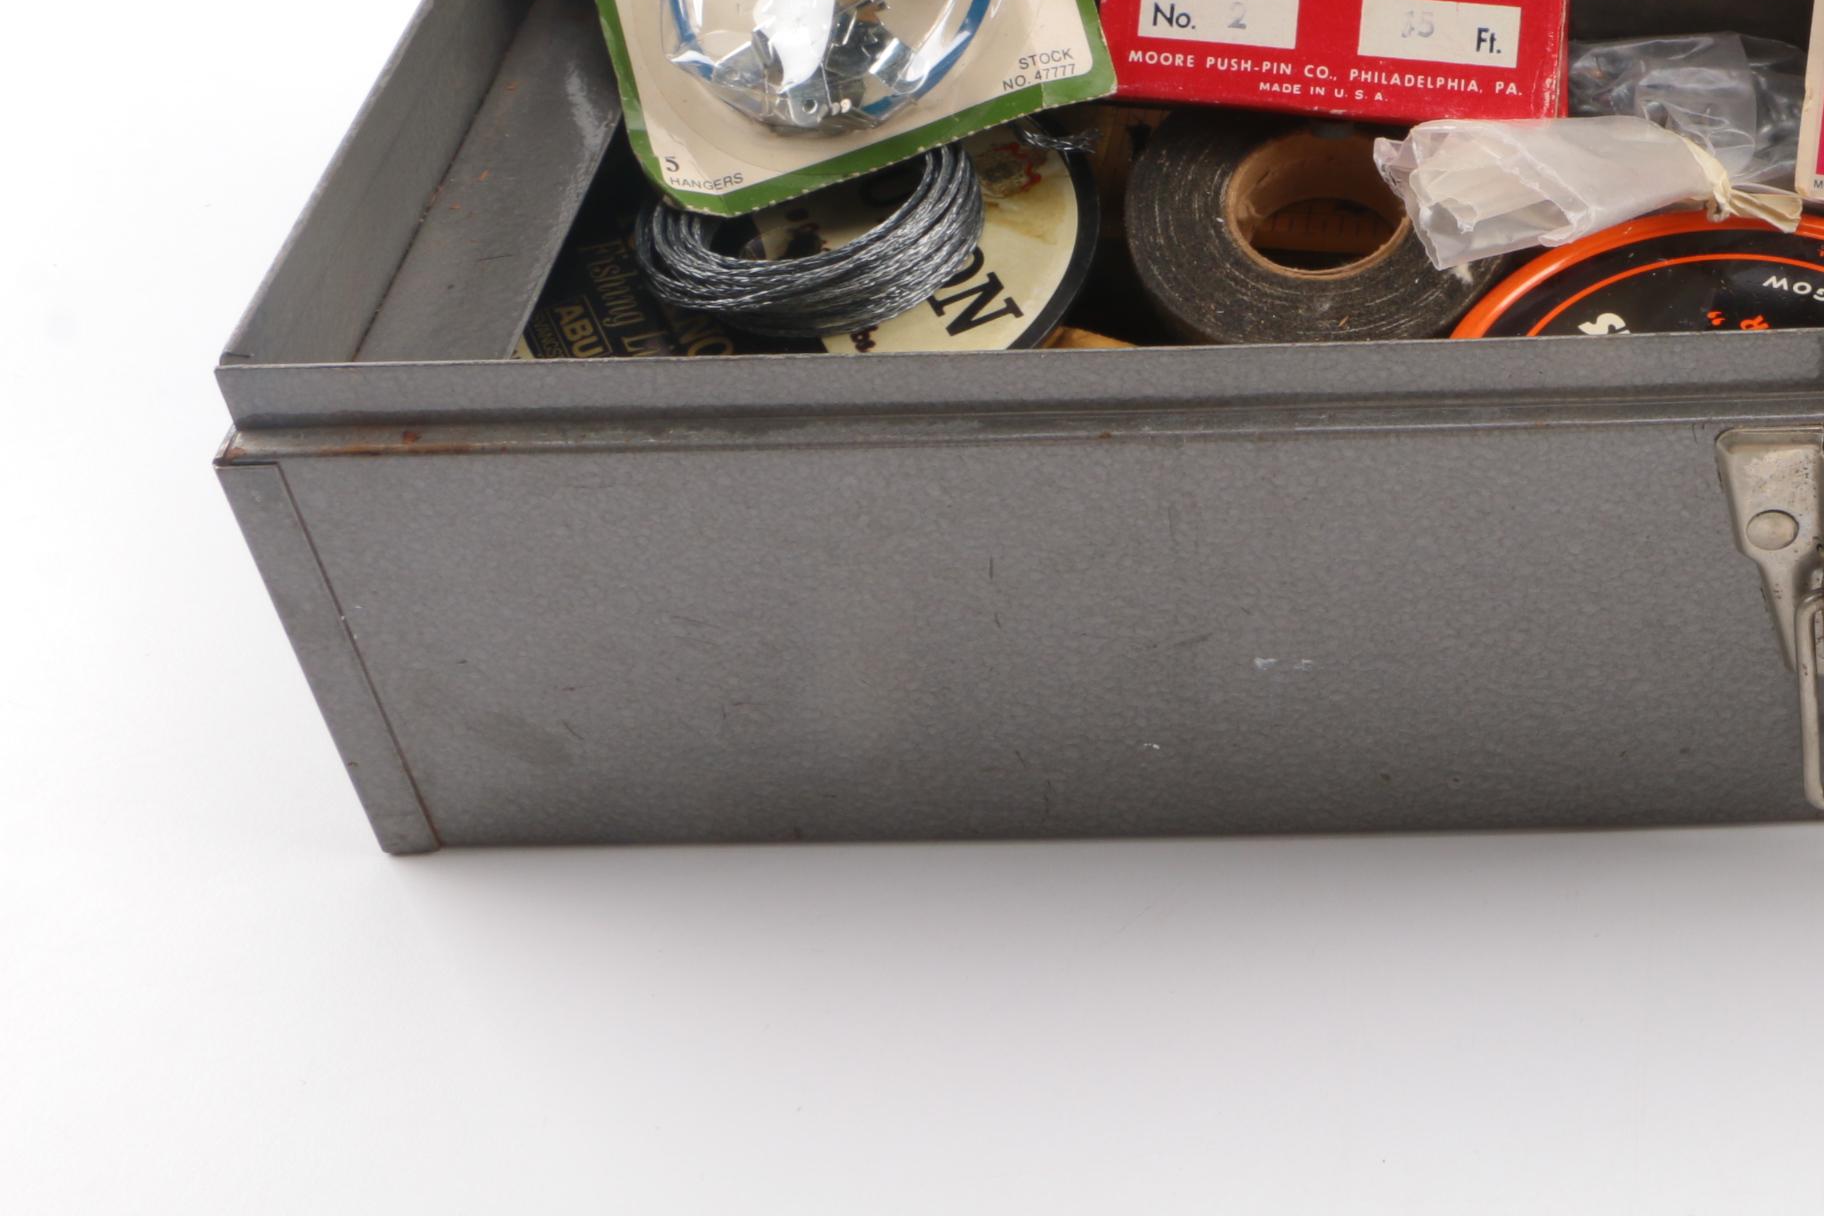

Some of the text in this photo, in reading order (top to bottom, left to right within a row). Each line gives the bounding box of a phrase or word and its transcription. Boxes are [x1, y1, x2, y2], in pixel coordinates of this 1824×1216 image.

[1153, 2, 1248, 30] No. 2
[1476, 28, 1502, 54] Ft.
[1019, 49, 1074, 70] STOCK
[1002, 65, 1075, 91] NO. 47777
[1129, 50, 1196, 68] MOORE
[1206, 57, 1292, 76] PUSH-PIN
[1495, 81, 1522, 96] PA.
[1259, 82, 1301, 95] MADE
[1309, 86, 1326, 97] IN
[665, 156, 679, 172] 5
[670, 173, 744, 191] HANGERS
